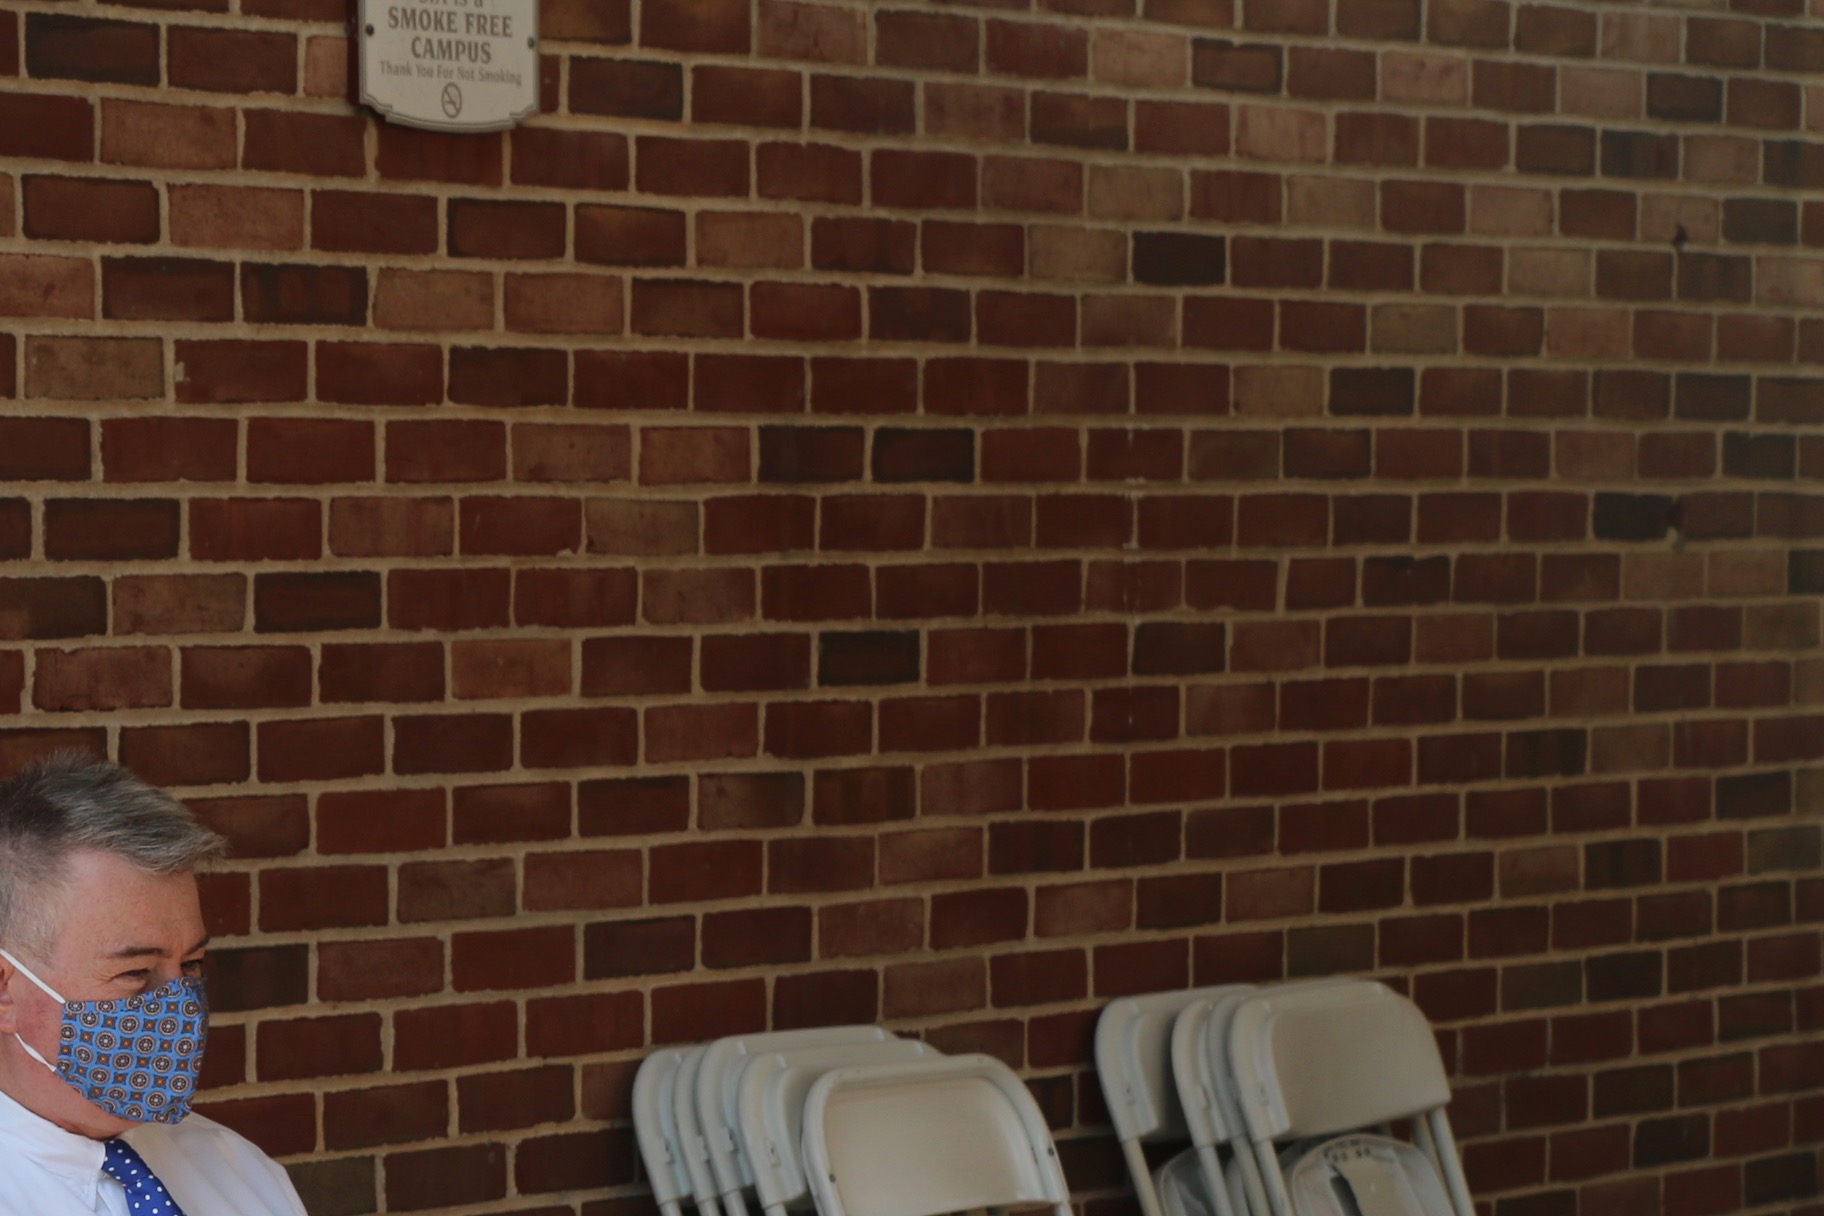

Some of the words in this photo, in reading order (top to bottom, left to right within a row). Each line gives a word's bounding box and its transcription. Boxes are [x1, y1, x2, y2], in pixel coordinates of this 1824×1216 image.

[388, 6, 458, 34] SMOKE
[465, 12, 513, 38] FREE
[411, 36, 492, 64] CAMPUS
[379, 60, 412, 77] Thank
[415, 64, 434, 78] You
[437, 65, 454, 80] For
[457, 67, 475, 82] Not
[478, 68, 522, 87] Smoking
